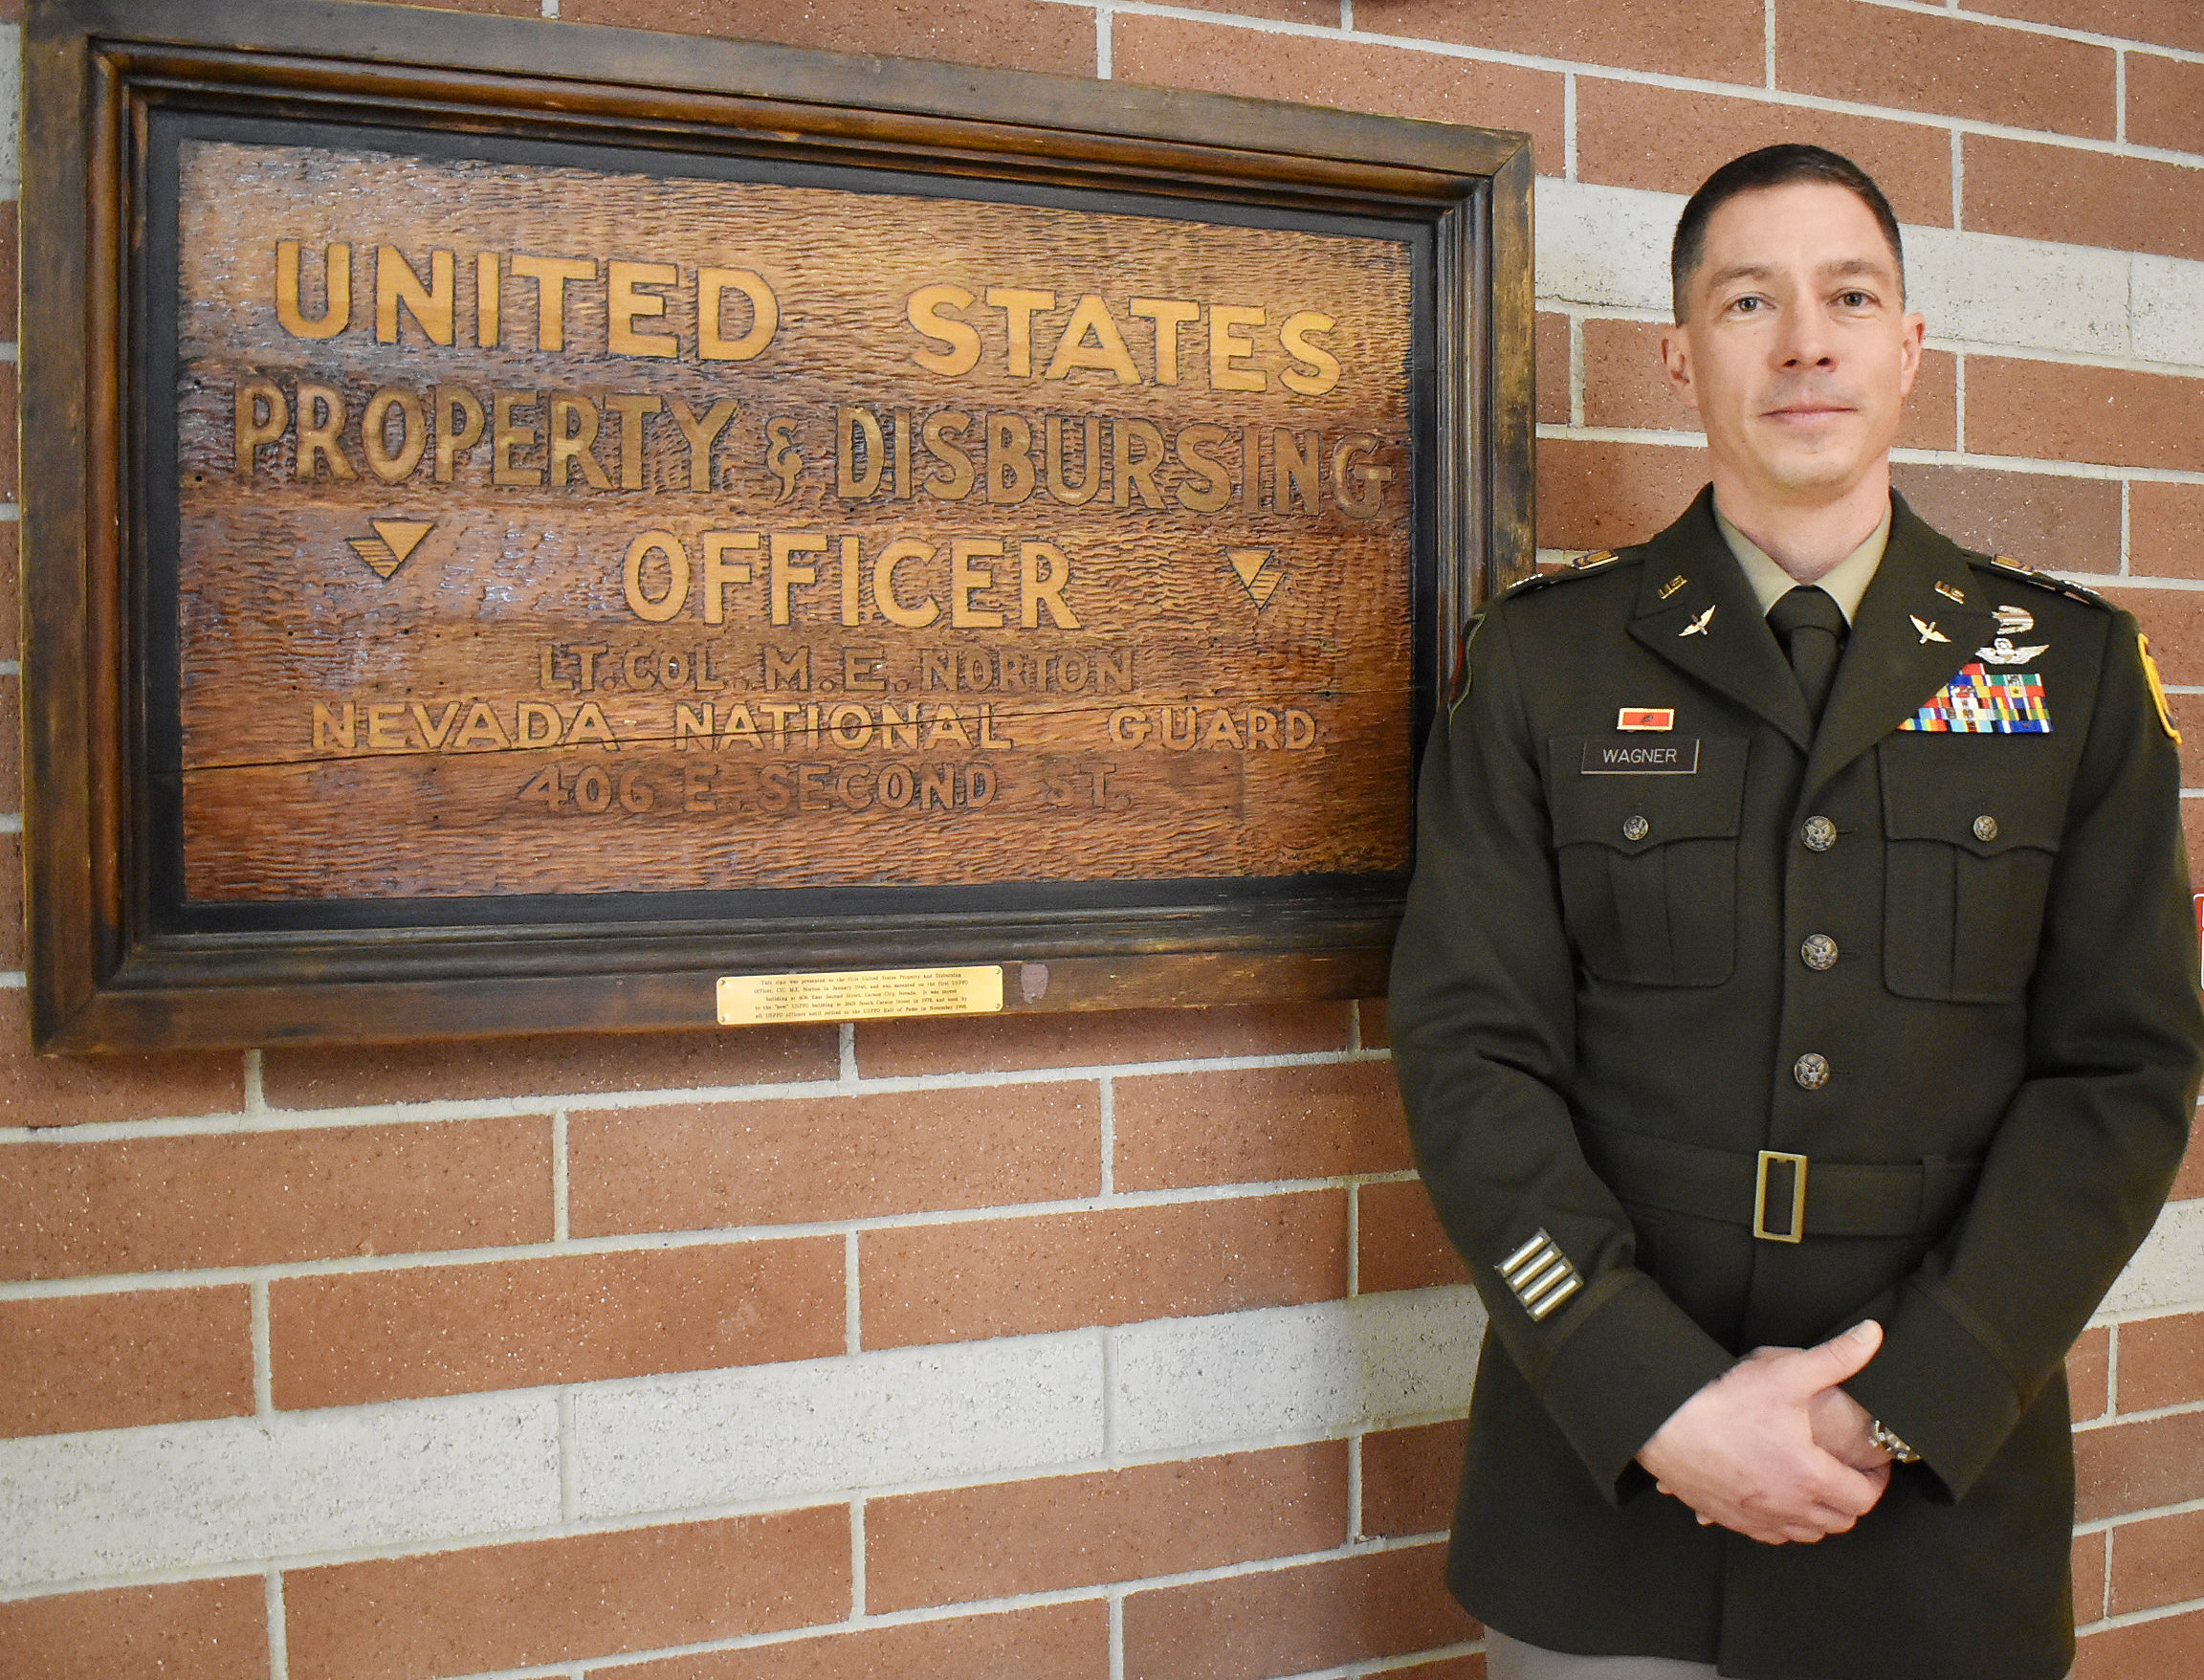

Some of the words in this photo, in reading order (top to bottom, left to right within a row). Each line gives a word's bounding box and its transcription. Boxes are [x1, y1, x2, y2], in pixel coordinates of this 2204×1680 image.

[276, 238, 780, 362] UNITED
[905, 283, 1341, 396] STATES
[233, 382, 739, 494] PROPERTY
[765, 414, 802, 502] &
[835, 405, 1393, 519] DISBURSING
[622, 528, 1082, 630] OFFICER
[919, 646, 1135, 693] NORTON
[311, 699, 622, 754] NEVADA
[675, 700, 1014, 753] NATIONAL
[1108, 704, 1318, 751] GUARD
[1602, 748, 1678, 763] WAGNER
[517, 764, 656, 814] 406
[759, 763, 998, 813] SECOND
